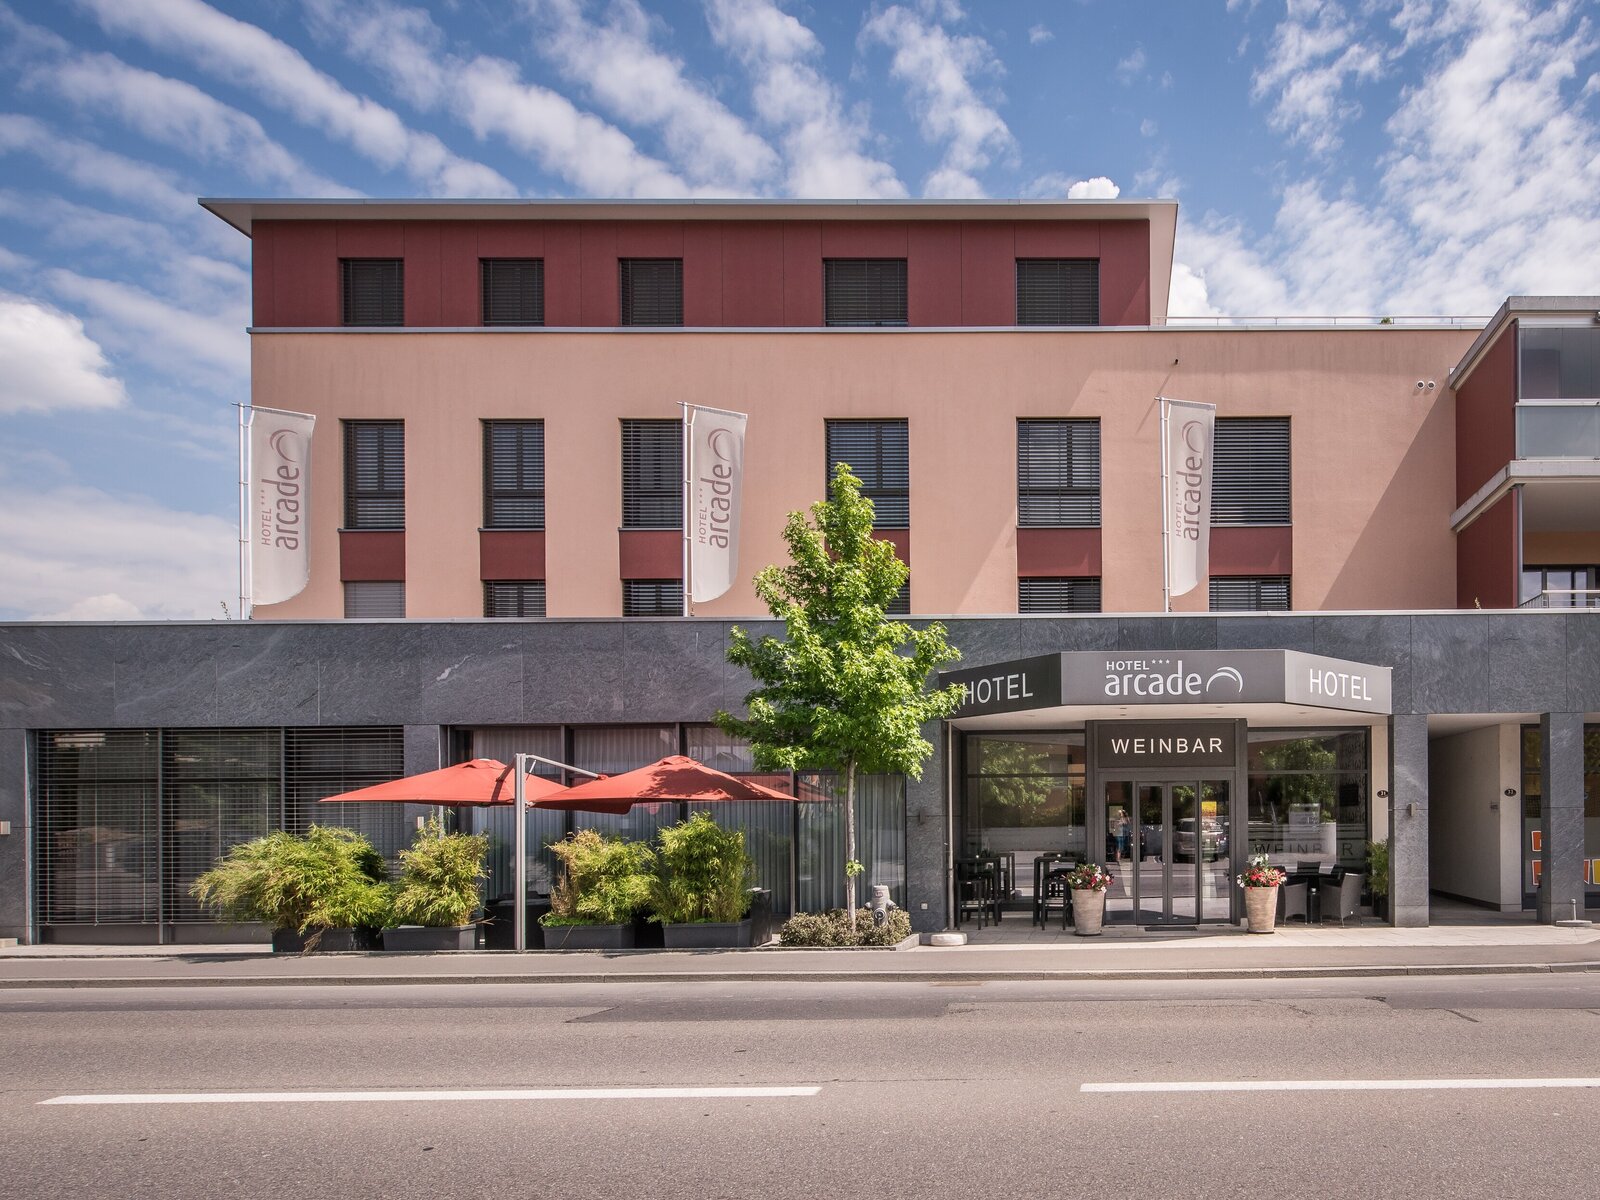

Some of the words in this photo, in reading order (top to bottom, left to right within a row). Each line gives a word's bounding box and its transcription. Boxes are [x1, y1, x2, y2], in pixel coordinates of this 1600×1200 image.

[261, 465, 300, 551] arcade
[700, 464, 732, 549] arcade
[1175, 456, 1203, 541] arcade
[261, 508, 272, 546] HOTEL
[699, 506, 707, 544] HOTEL
[1104, 660, 1201, 696] arcade
[1106, 660, 1150, 671] HOTEL
[1309, 668, 1372, 701] HOTEL
[1111, 738, 1223, 754] WEINBAR
[1254, 842, 1354, 856] WEINBR
